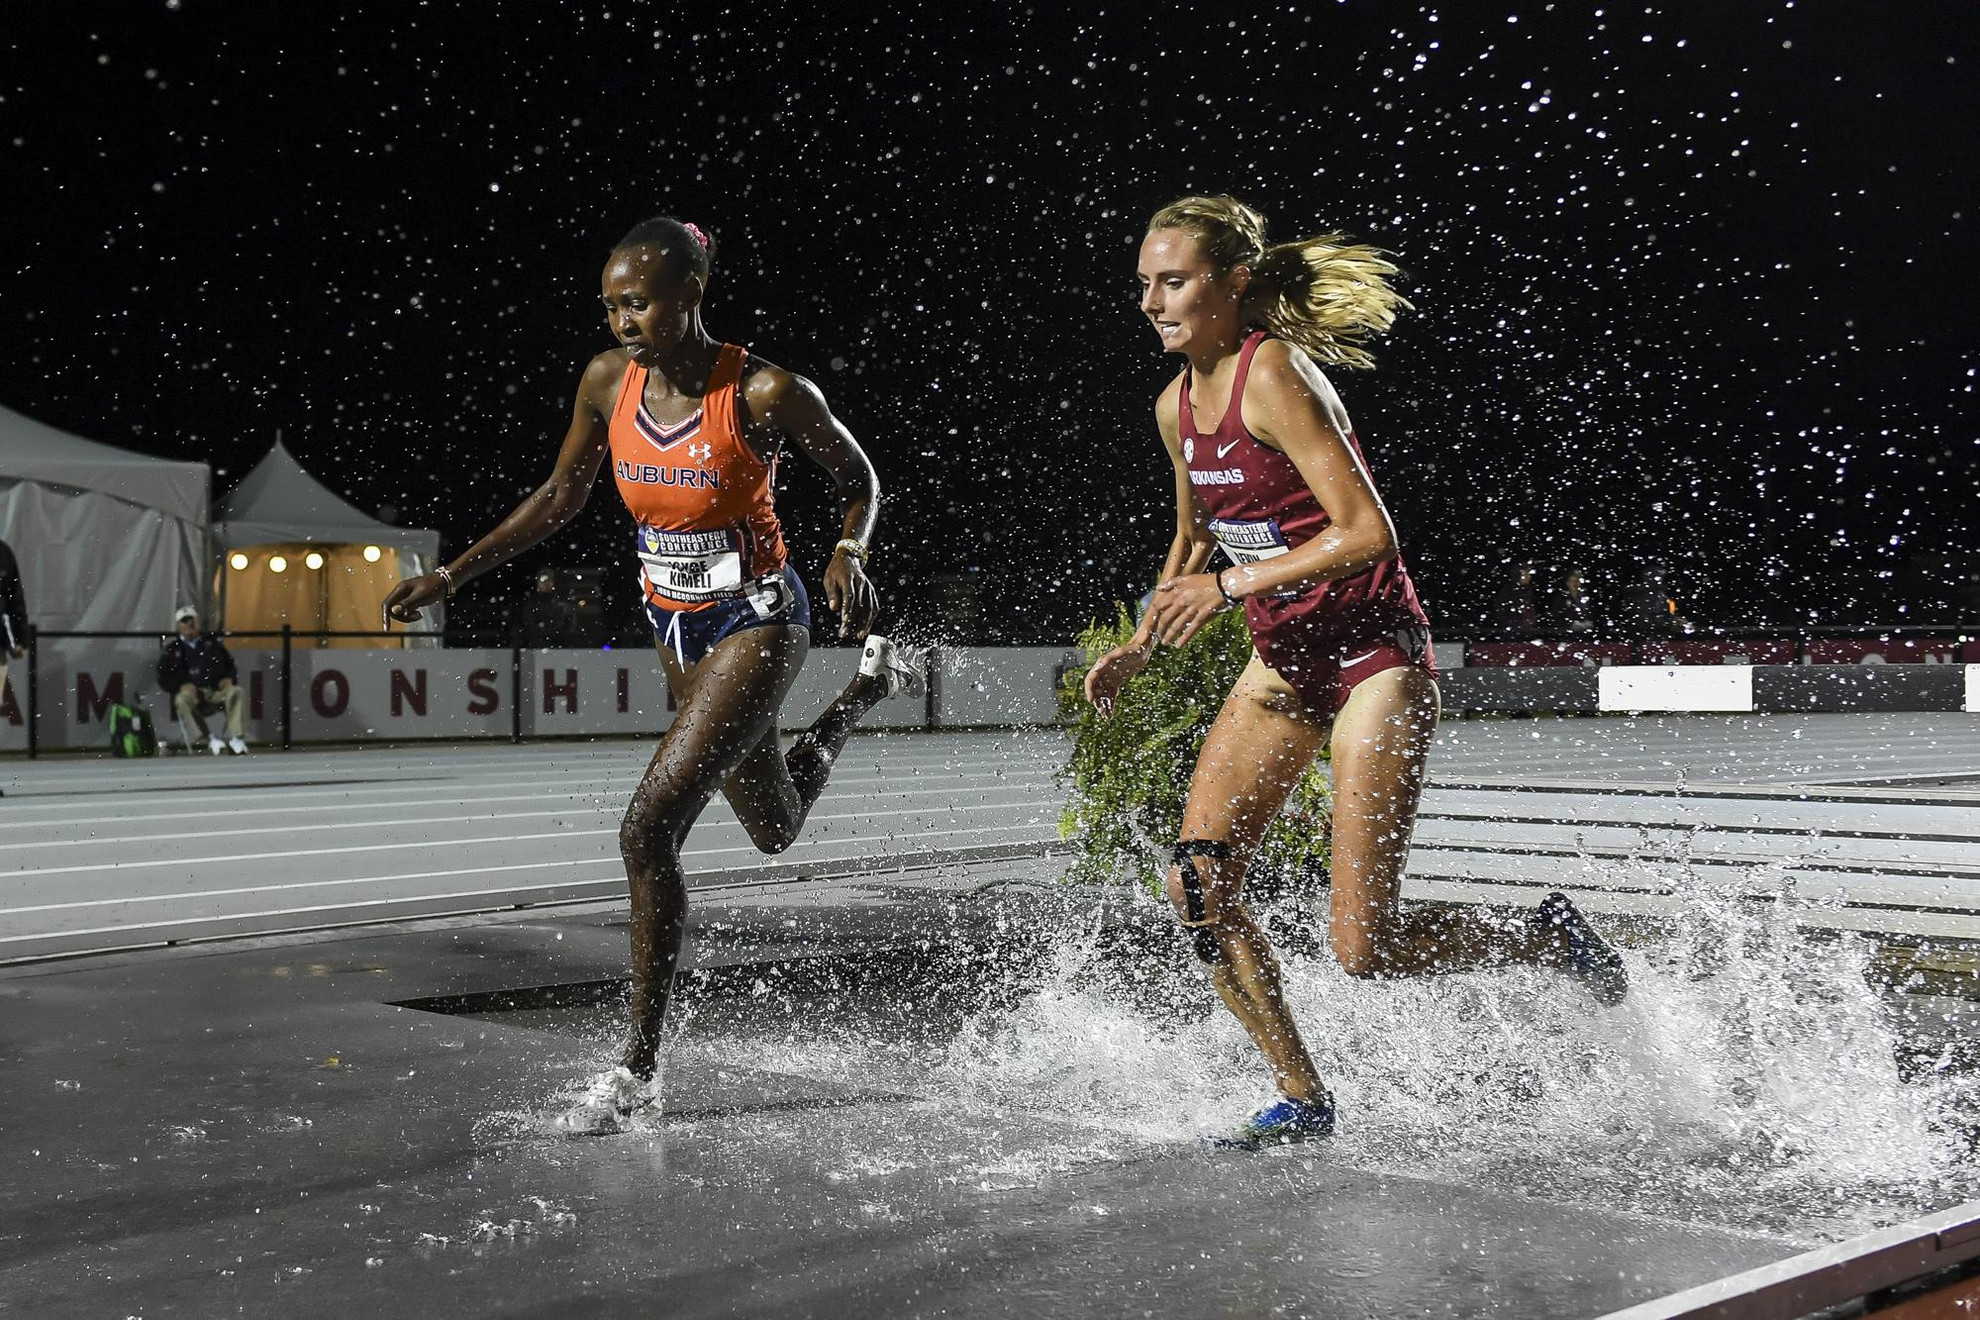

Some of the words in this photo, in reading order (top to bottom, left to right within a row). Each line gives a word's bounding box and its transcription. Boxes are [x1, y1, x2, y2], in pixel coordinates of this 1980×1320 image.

[616, 459, 720, 489] AUBURN
[658, 530, 727, 543] SOUTHEASTERN
[660, 539, 729, 551] CONFERENCE
[670, 571, 711, 588] KIMELI
